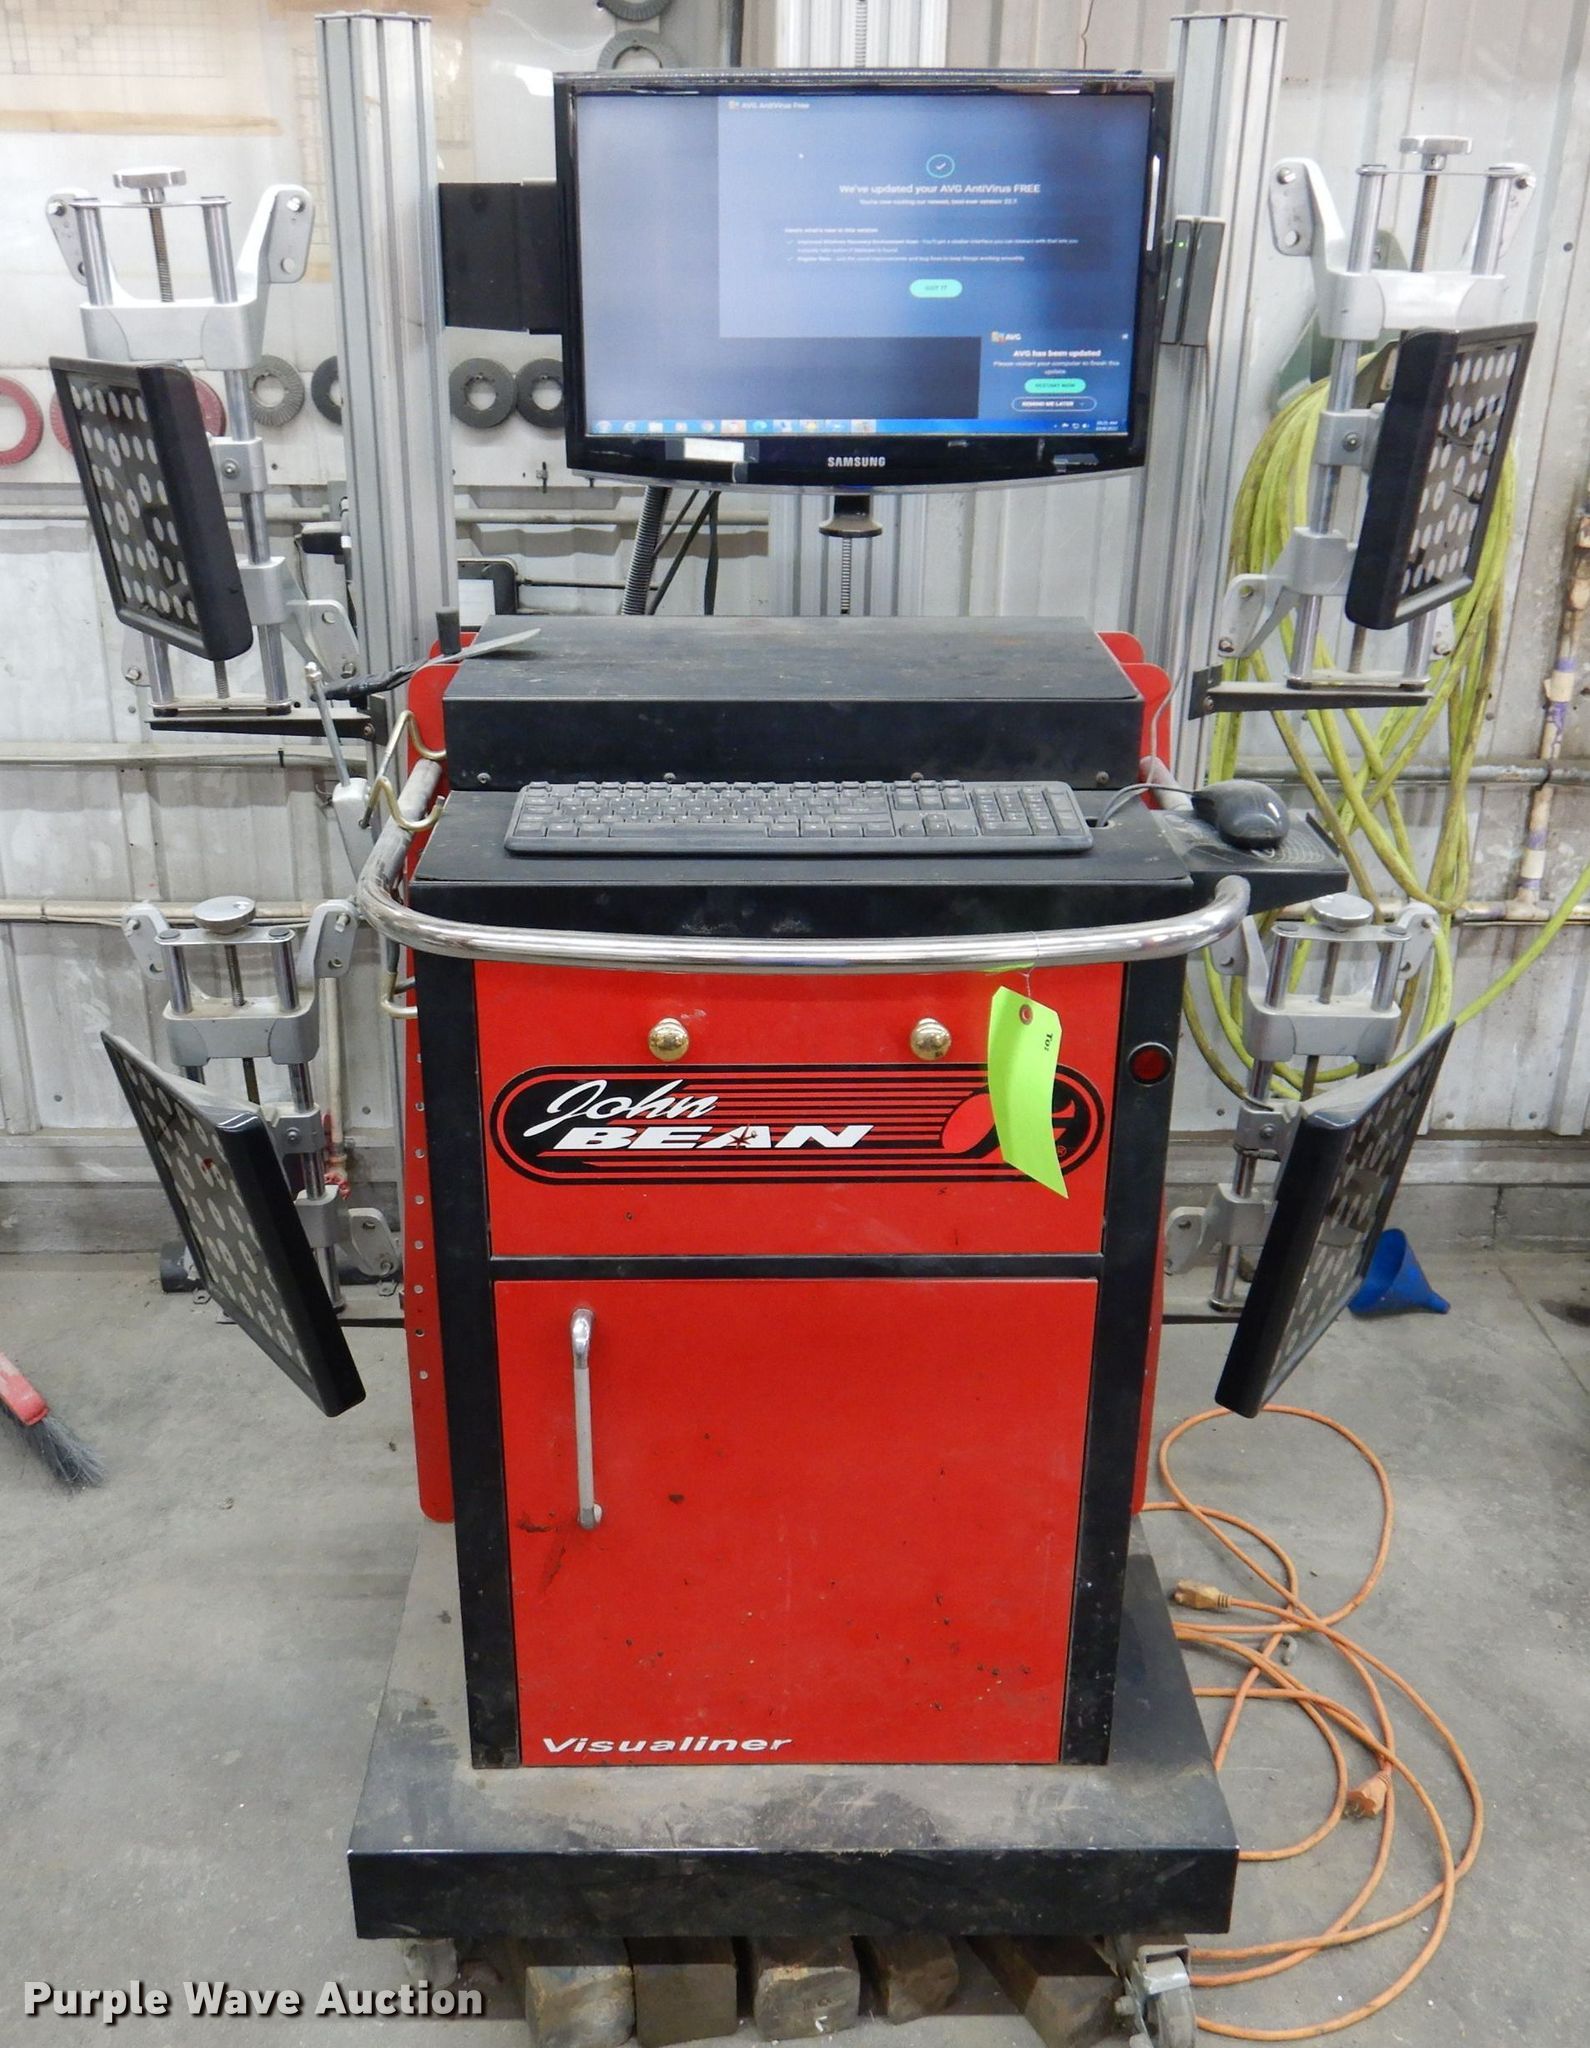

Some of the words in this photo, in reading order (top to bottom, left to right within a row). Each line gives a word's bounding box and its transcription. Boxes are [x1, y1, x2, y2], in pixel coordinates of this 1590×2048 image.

[839, 184, 868, 193] We've
[871, 184, 913, 195] updated
[915, 186, 939, 195] your
[940, 184, 963, 193] AVG
[964, 184, 1011, 193] AntiVirus
[1013, 184, 1041, 193] FREE
[1069, 350, 1102, 358] updated
[827, 456, 886, 468] SAMSUNG
[1044, 1032, 1054, 1052] To:
[523, 1079, 719, 1138] John
[552, 1124, 875, 1150] BEAN
[542, 1736, 793, 1753] Visualiner
